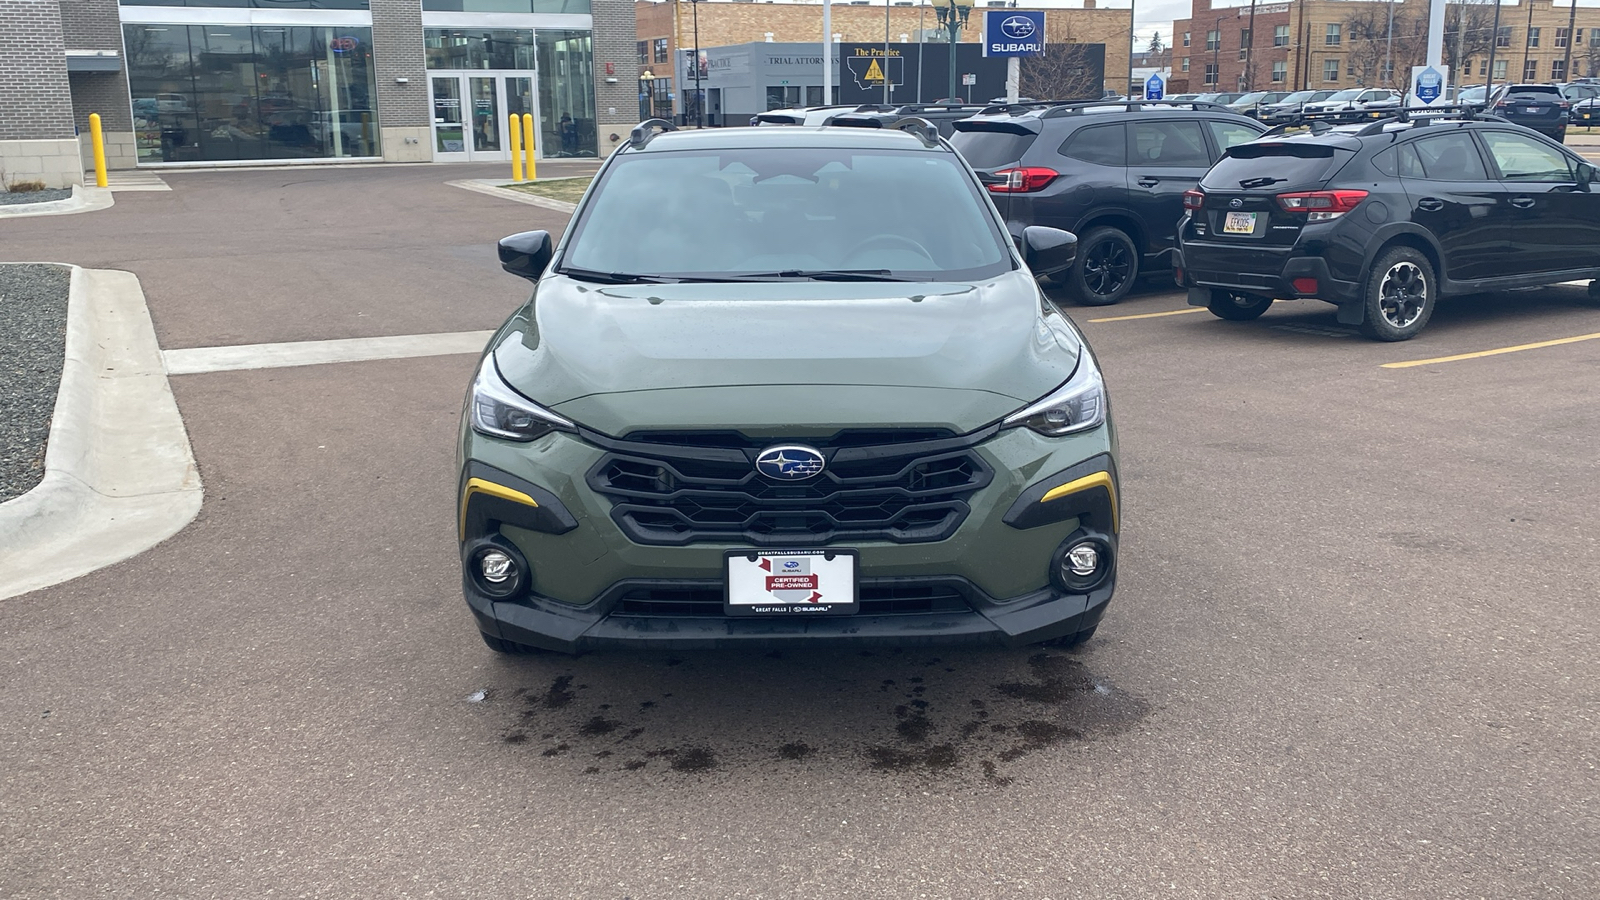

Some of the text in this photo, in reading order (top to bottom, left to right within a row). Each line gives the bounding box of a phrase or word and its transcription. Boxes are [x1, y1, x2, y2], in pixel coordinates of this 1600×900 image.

[992, 43, 1041, 52] SUBARU
[854, 48, 900, 56] The Pratice
[769, 57, 839, 65] TRIAL ATTORNYS
